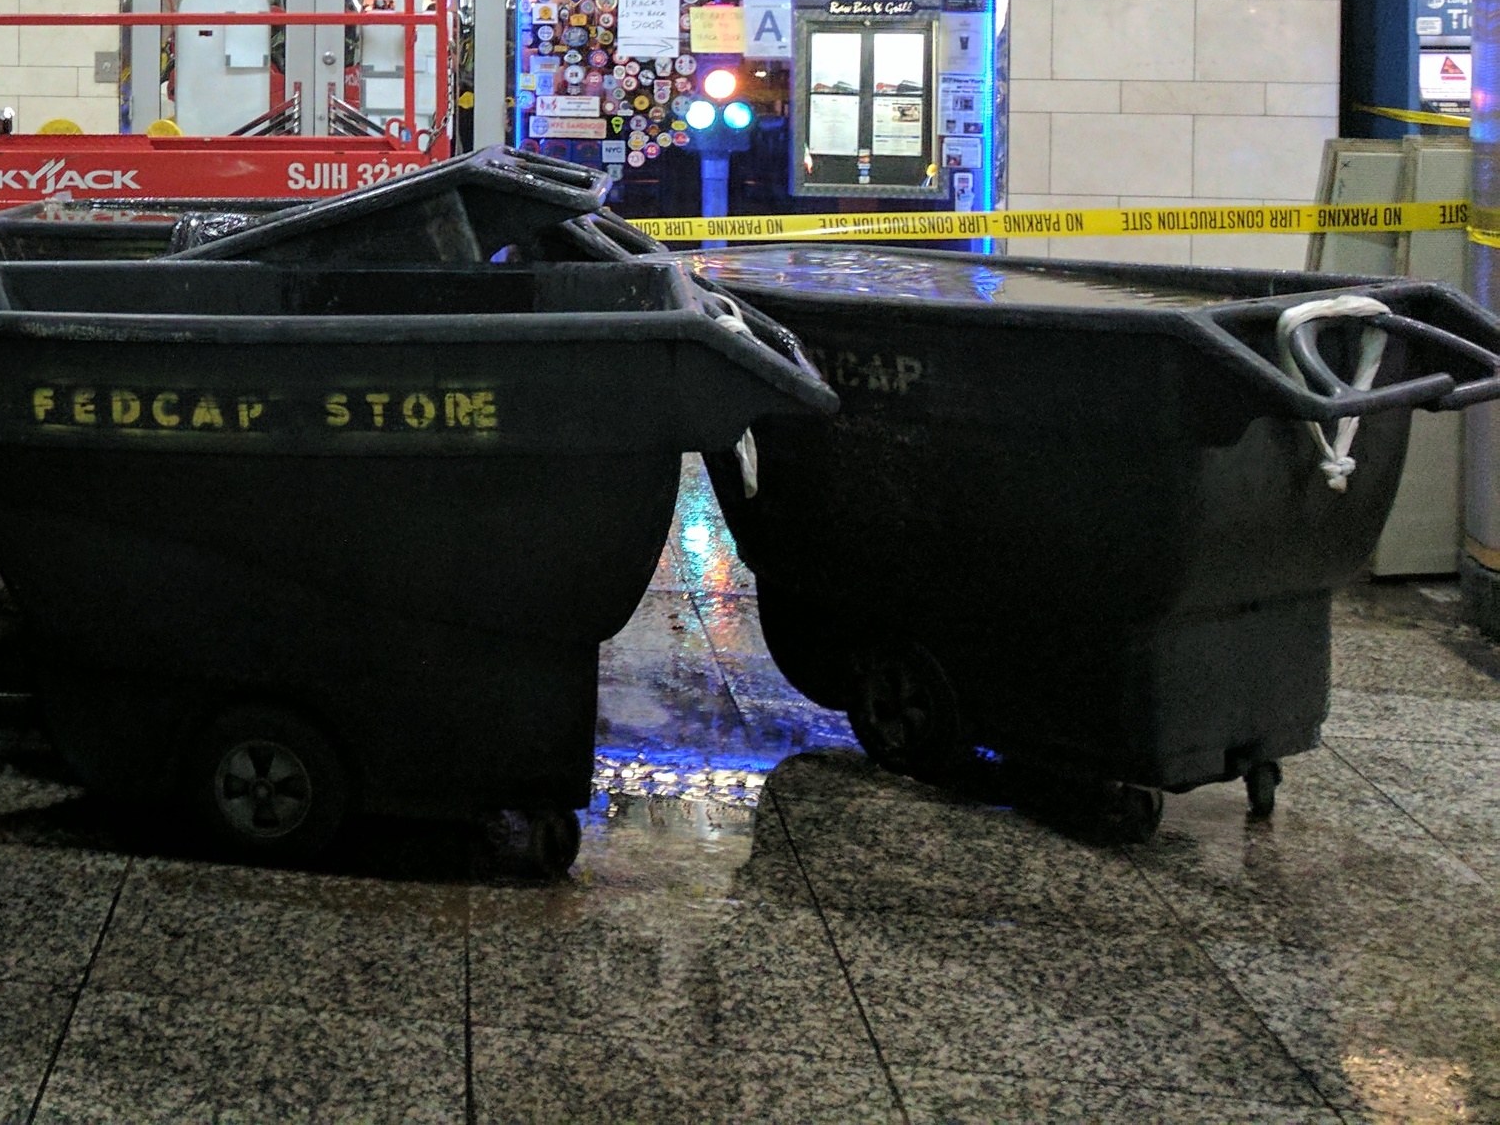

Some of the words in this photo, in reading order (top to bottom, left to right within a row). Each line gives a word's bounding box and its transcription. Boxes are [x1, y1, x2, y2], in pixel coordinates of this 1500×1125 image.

[853, 1, 872, 13] Bar
[884, 1, 913, 15] Grill
[753, 9, 783, 42] A
[287, 162, 349, 190] SJIH
[1004, 213, 1061, 233] PARKING
[1066, 213, 1084, 232] NO
[1122, 212, 1152, 231] SITE
[1158, 210, 1264, 231] CONSTRUCTION
[1269, 209, 1301, 229] LIRR
[1318, 207, 1379, 227] PARKING
[1383, 207, 1403, 226] NO
[1439, 203, 1469, 224] SITE
[664, 221, 694, 236] LIRR
[707, 219, 762, 236] PARKING
[766, 219, 784, 235] NO
[819, 217, 850, 235] SITE
[853, 215, 954, 235] CONSTRUCTION
[958, 215, 988, 234] LIRR
[817, 349, 924, 394] CAP
[32, 388, 264, 429] FEDCAP
[325, 390, 499, 429] STORE
